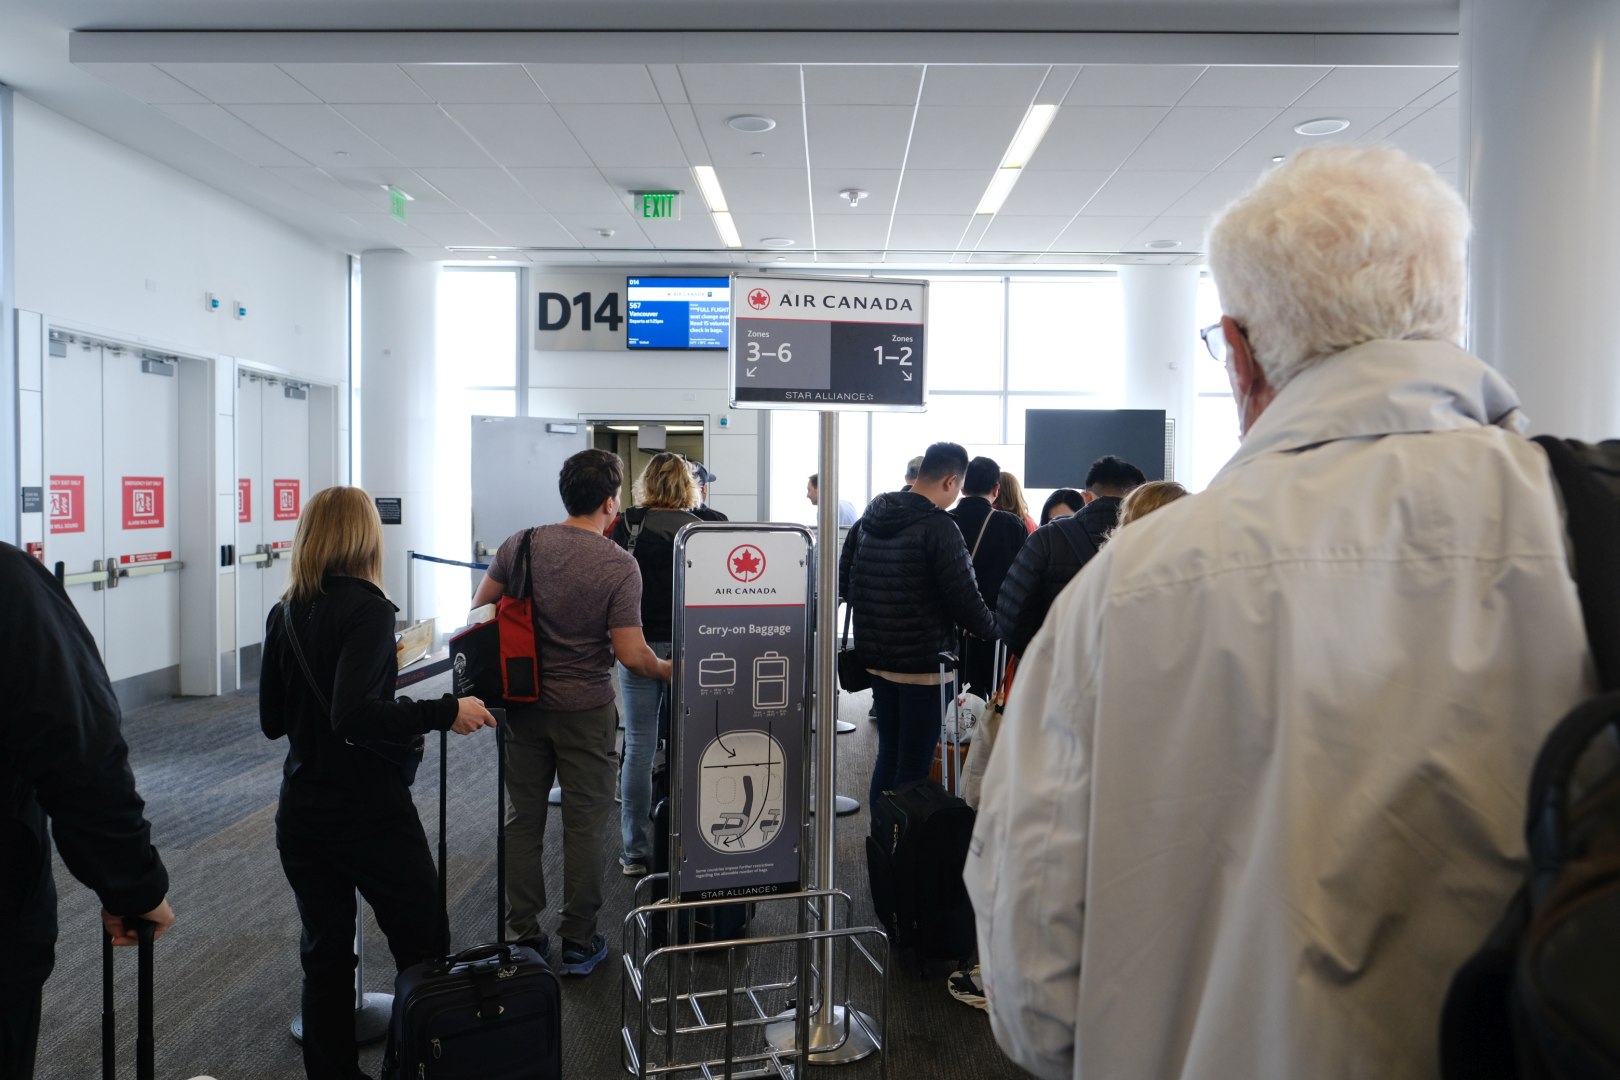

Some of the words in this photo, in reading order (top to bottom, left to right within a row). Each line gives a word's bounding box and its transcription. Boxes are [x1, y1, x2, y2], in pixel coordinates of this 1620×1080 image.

[643, 194, 675, 218] EXIT
[779, 294, 816, 308] AIR
[822, 295, 913, 312] CANADA
[538, 292, 623, 331] D14
[747, 330, 770, 338] Zones
[891, 335, 914, 343] Zones
[785, 391, 812, 400] STAR
[815, 392, 866, 401] ALLIANCE
[735, 587, 777, 595] CANADA
[698, 625, 746, 637] Carry-on
[748, 624, 791, 636] Baggage
[701, 890, 724, 899] STAR
[726, 885, 770, 896] ALLIANCE
